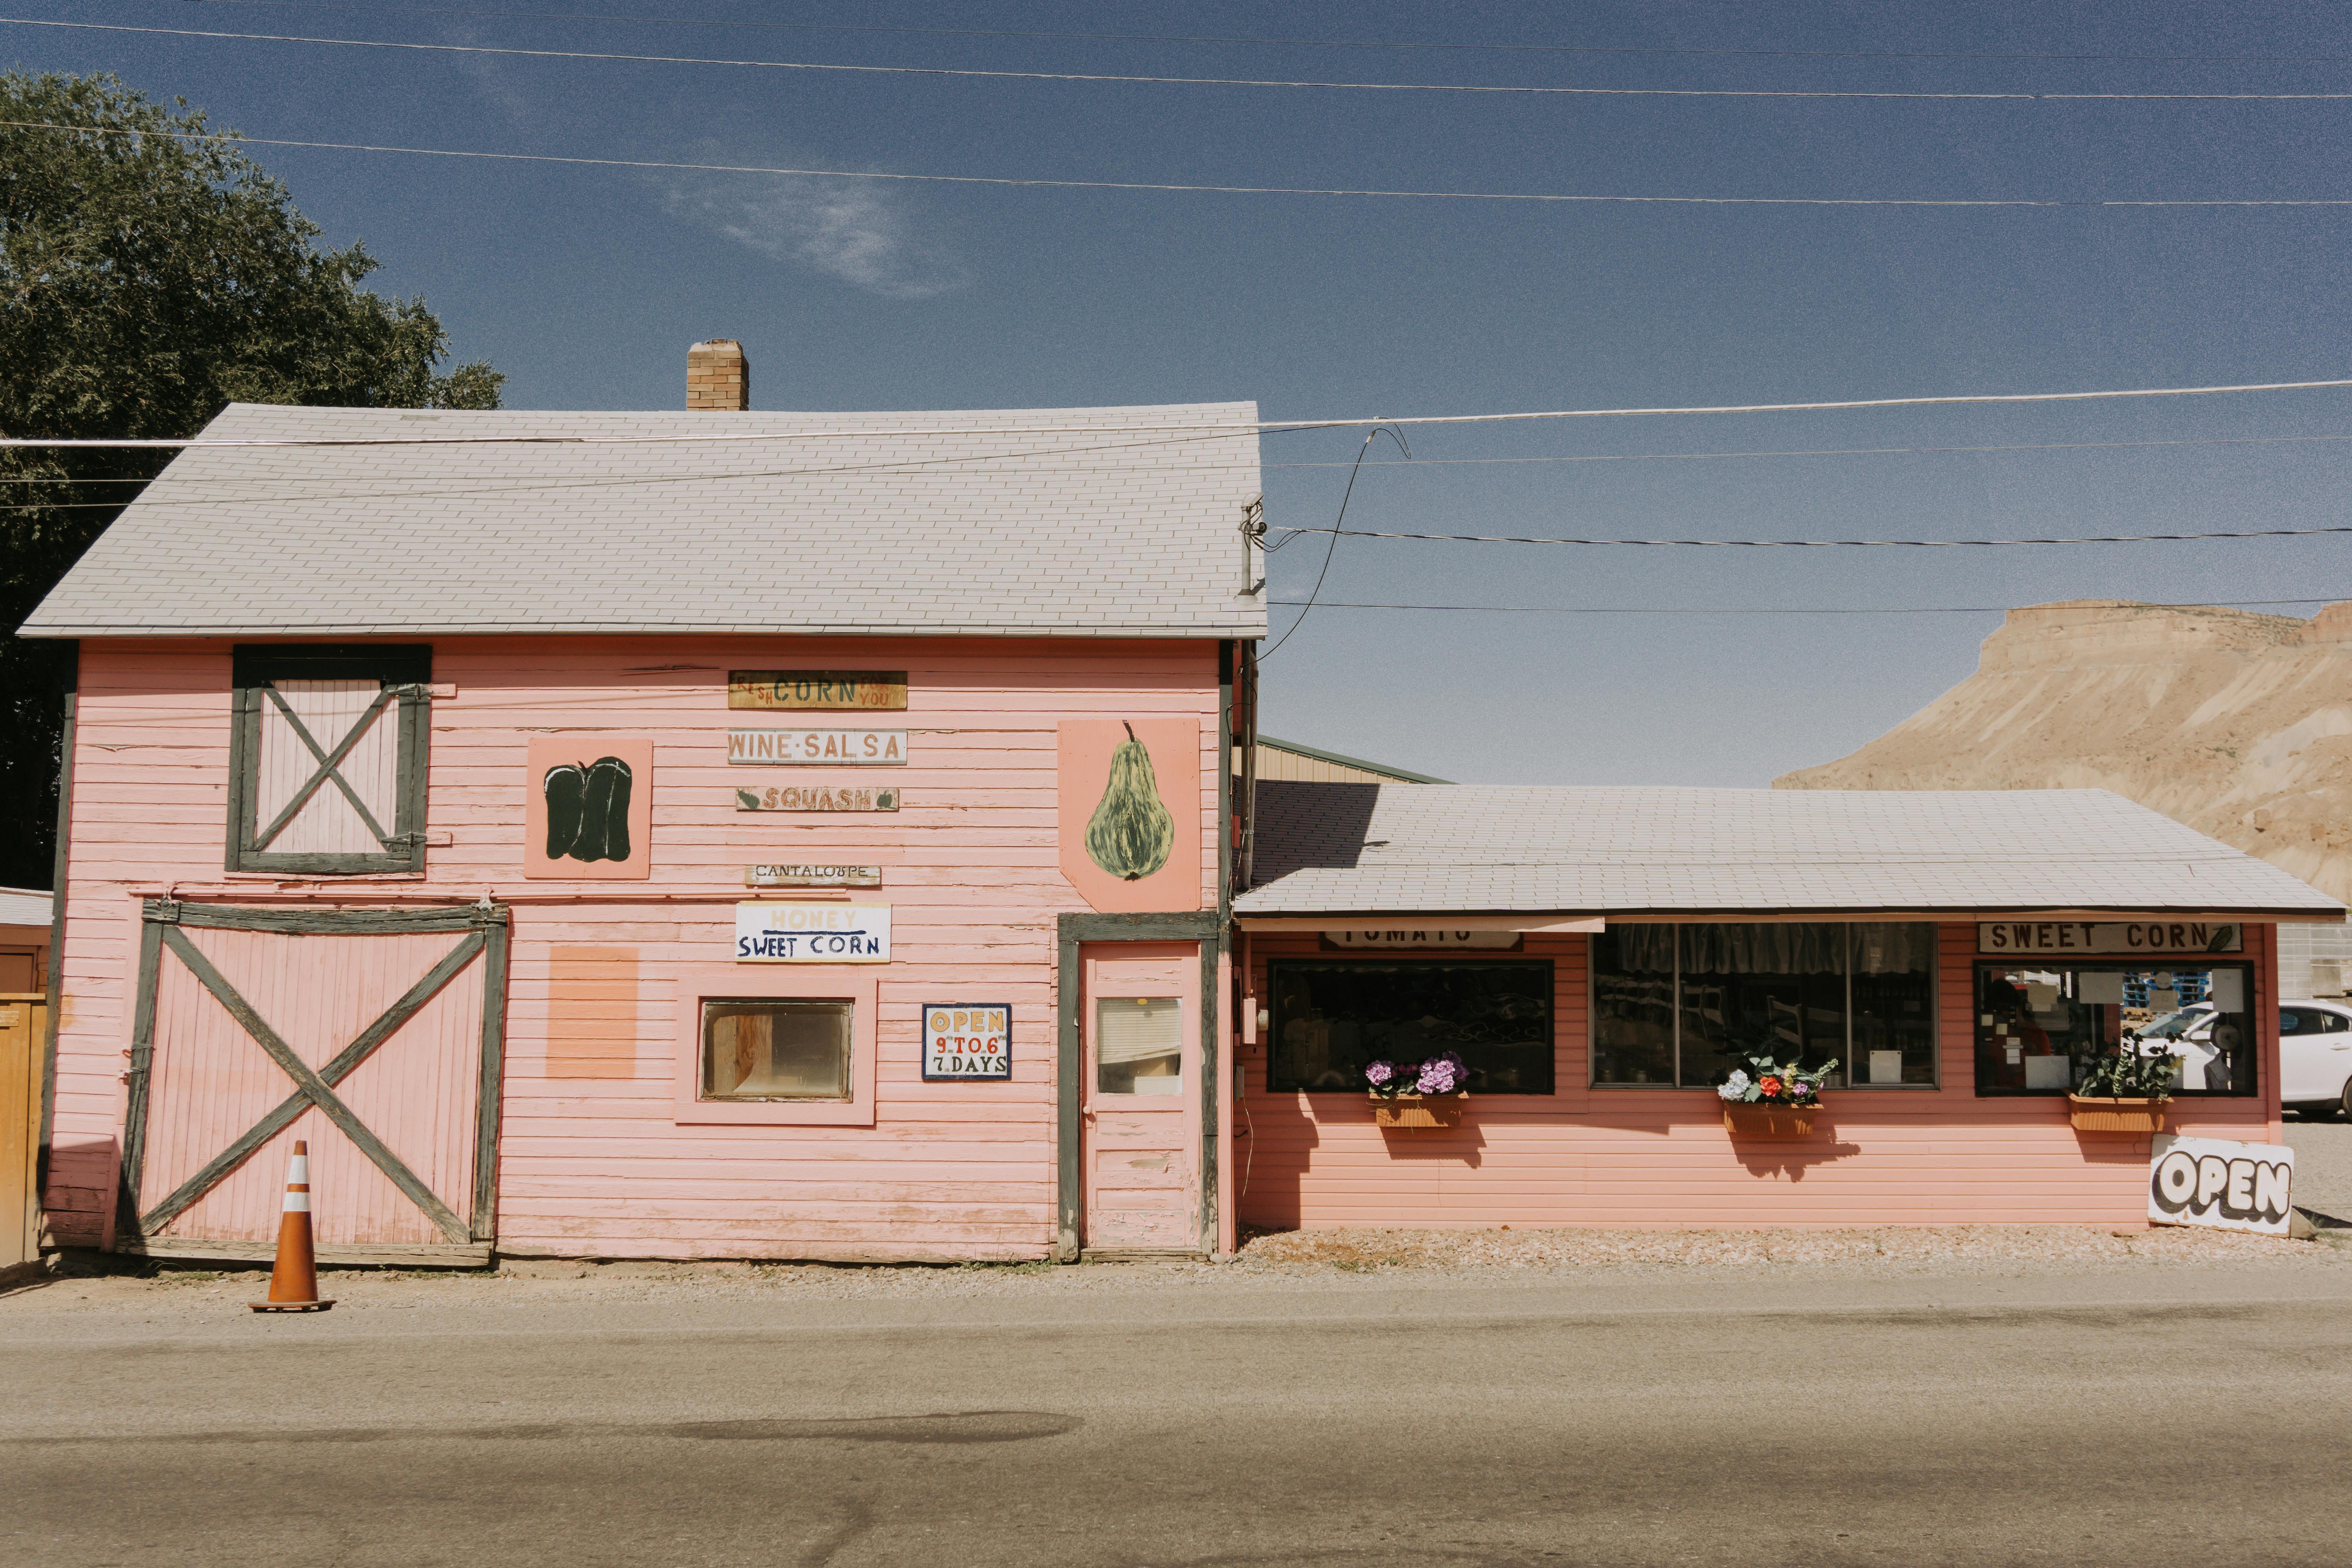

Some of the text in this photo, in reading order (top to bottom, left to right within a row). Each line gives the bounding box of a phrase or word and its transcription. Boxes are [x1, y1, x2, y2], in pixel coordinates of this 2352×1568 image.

[774, 678, 855, 702] CORN
[860, 676, 889, 690] FOR
[860, 693, 889, 706] YOU
[762, 788, 870, 810] SQUASH
[756, 865, 868, 877] CANTALOUPE
[771, 910, 856, 928] HONEY
[1992, 923, 2208, 948] SWEET CORN
[737, 936, 879, 957] SWEET CORN
[931, 1011, 1003, 1032] OPEN
[936, 1037, 946, 1054] 9
[954, 1037, 981, 1054] TO
[987, 1037, 998, 1054] 6
[933, 1056, 1007, 1072] 7 DAYS
[2155, 1151, 2292, 1221] OPEN
